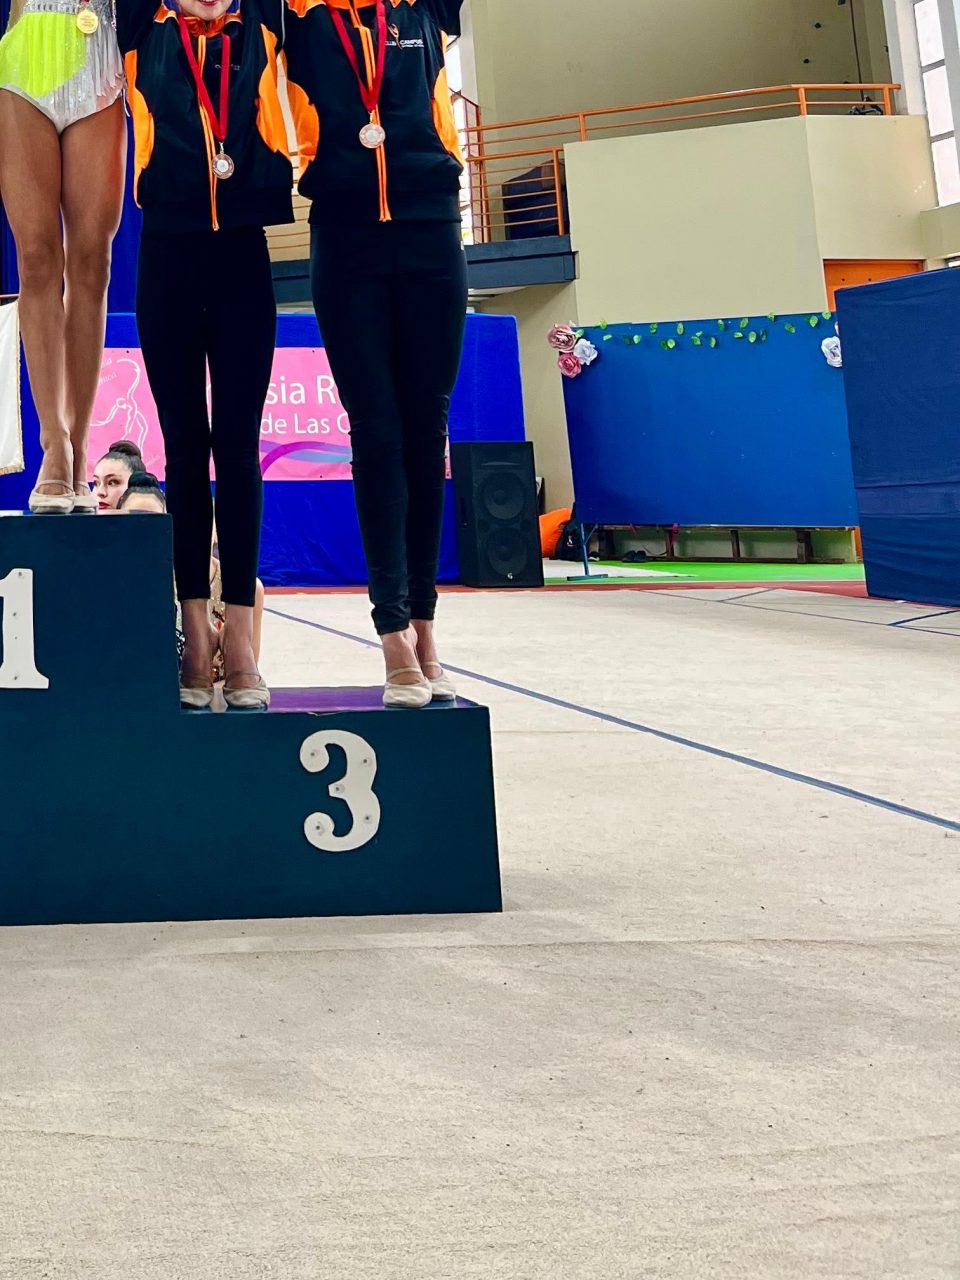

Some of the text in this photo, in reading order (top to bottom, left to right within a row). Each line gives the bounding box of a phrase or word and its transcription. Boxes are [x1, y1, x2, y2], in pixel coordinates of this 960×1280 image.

[265, 375, 338, 404] sia R
[260, 412, 351, 434] de Las C
[299, 729, 381, 851] 3
